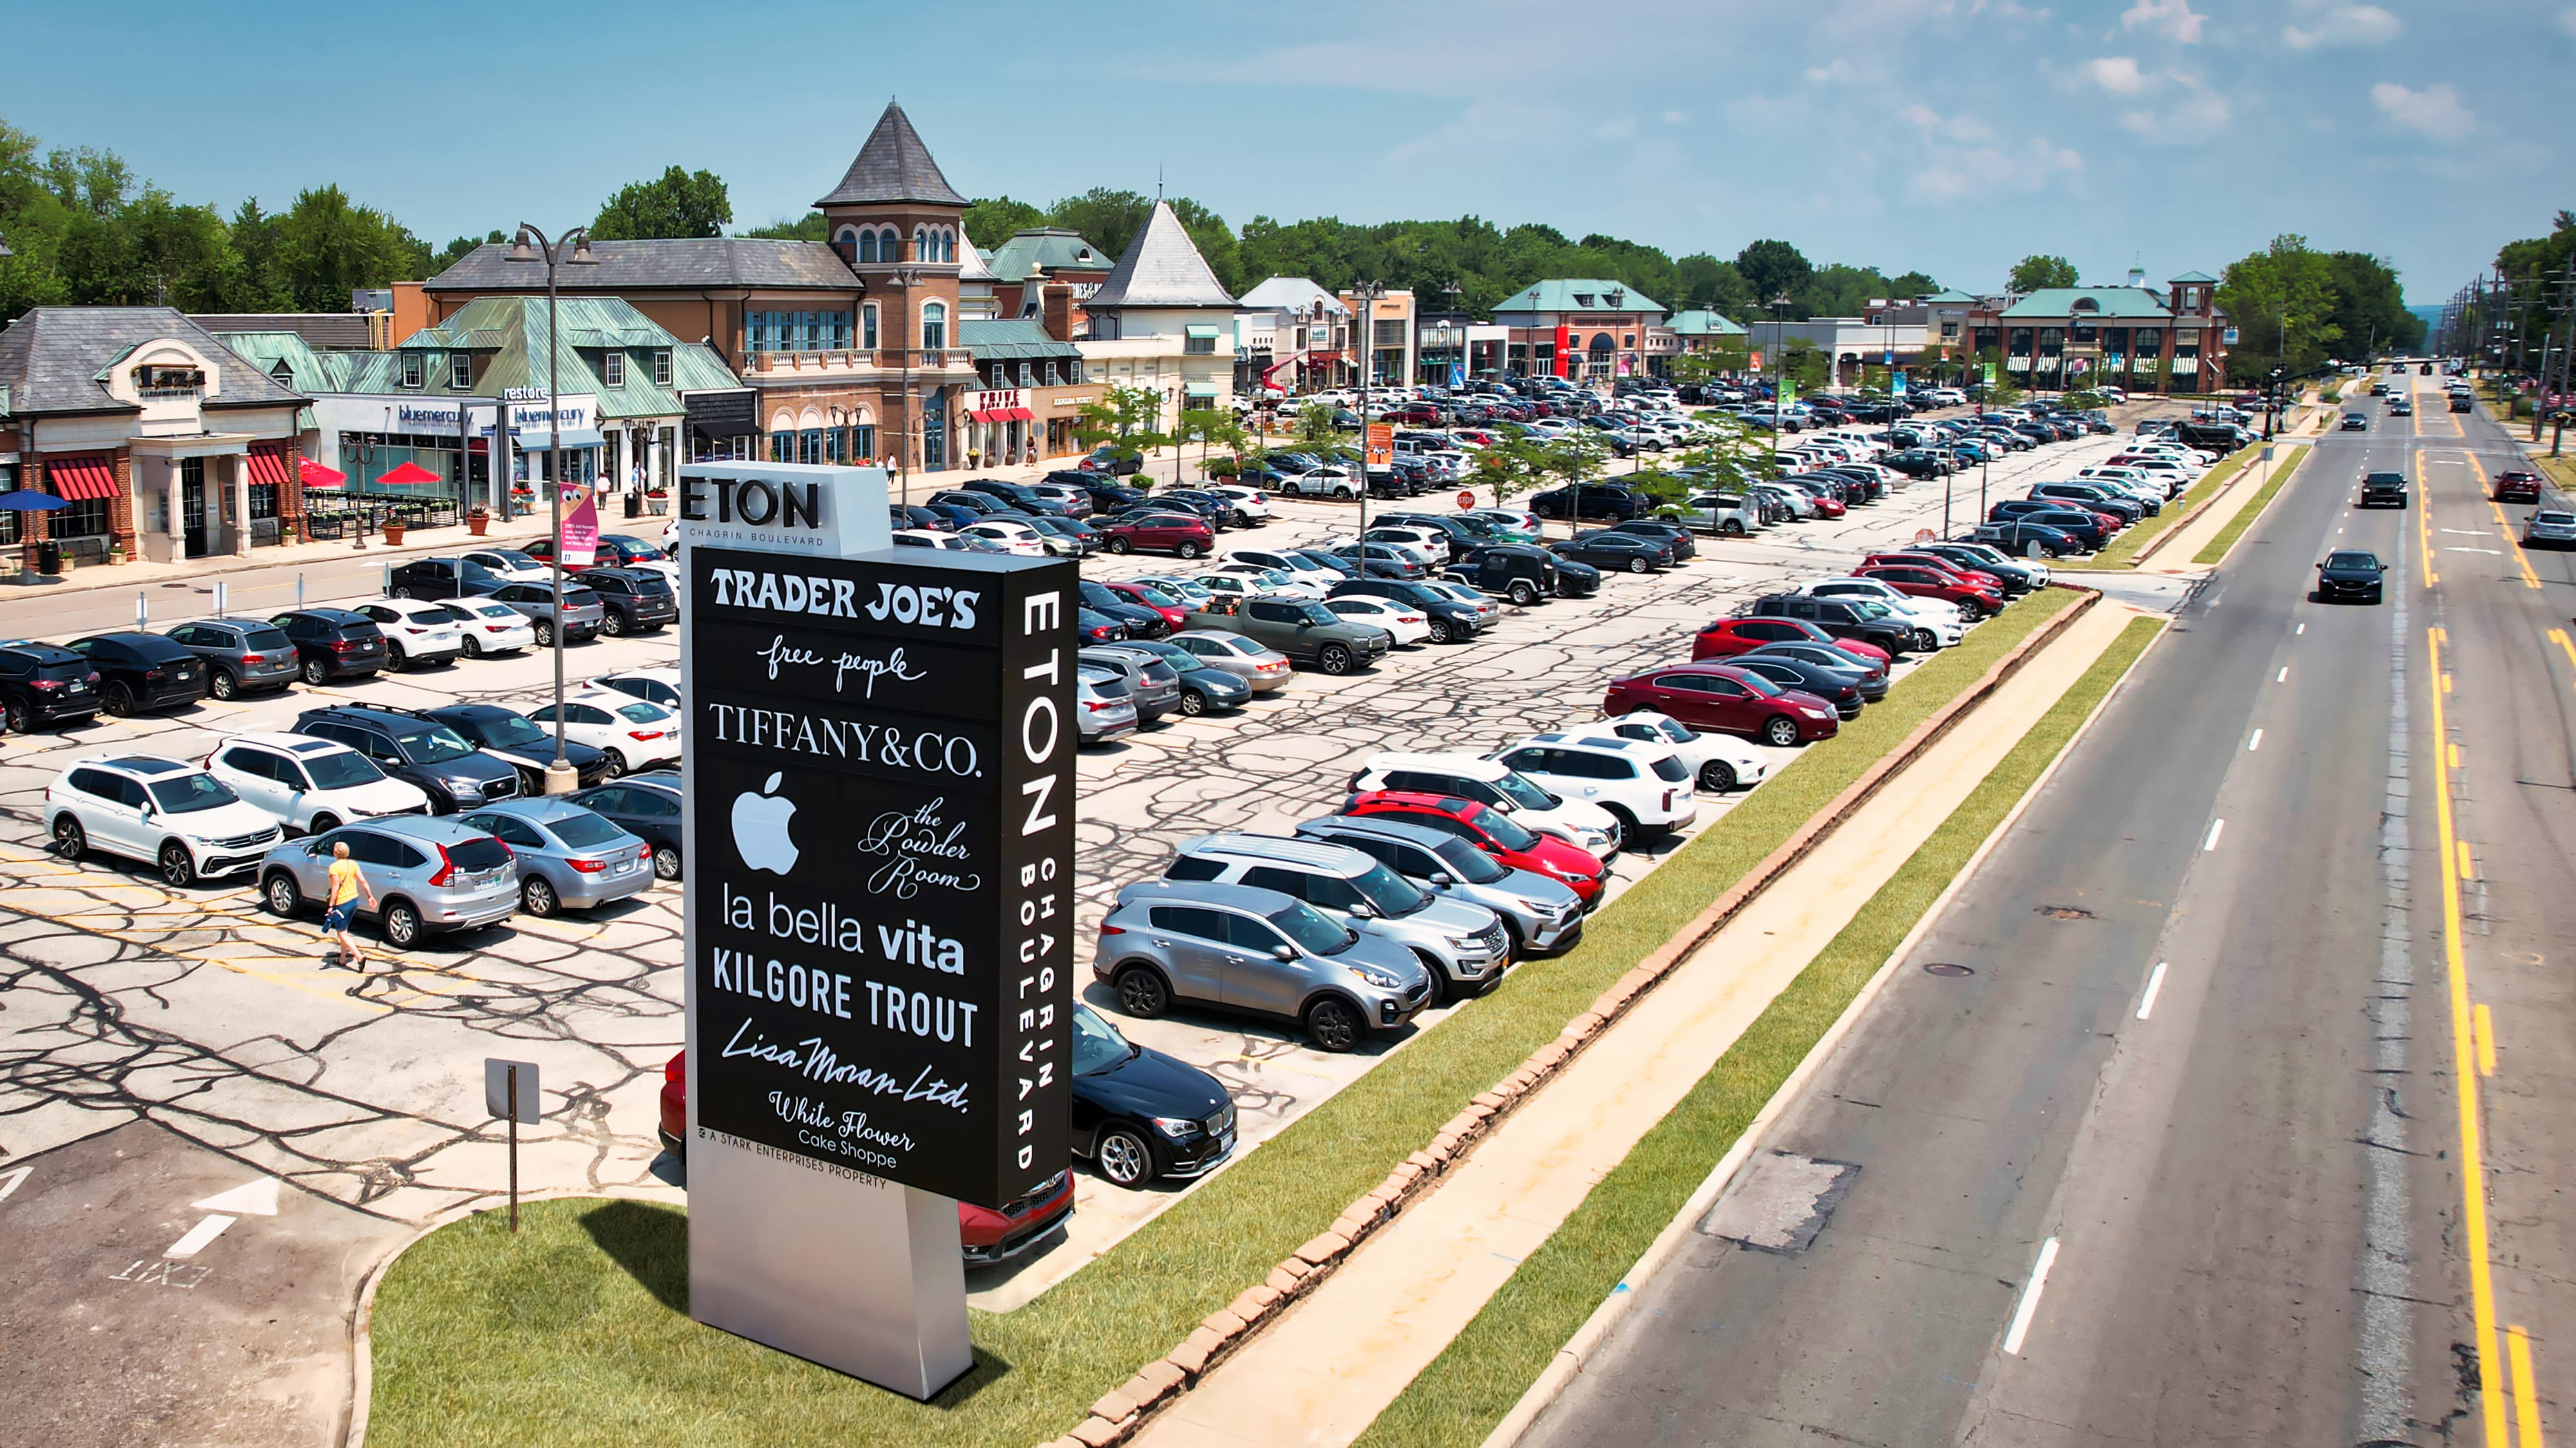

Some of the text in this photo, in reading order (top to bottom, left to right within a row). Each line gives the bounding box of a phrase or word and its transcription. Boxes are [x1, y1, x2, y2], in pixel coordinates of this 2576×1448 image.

[399, 405, 473, 425] bluemercuy
[504, 385, 547, 399] restore
[680, 476, 819, 529] ETON
[690, 528, 823, 546] CHAGRIN BOULEVARD
[710, 569, 980, 629] TRADER JOE'S
[757, 635, 927, 698] free people
[709, 704, 981, 777] TIFFANY&CO.
[1022, 591, 1059, 836] ETON
[858, 812, 971, 859] Powder
[914, 797, 943, 826] the
[868, 850, 980, 899] Room
[724, 882, 963, 975] la bella vita
[714, 948, 977, 1047] KILGORE TROUT
[1039, 858, 1056, 1087] CHAGRIN
[1019, 864, 1036, 1169] BOULEVARD
[722, 1018, 968, 1113] Lisa Moran Ltd.
[769, 1091, 914, 1151] White Flower
[799, 1130, 896, 1168] Cake Shoppe
[710, 1132, 886, 1190] A STARK ENTERPRISES PROPERTY
